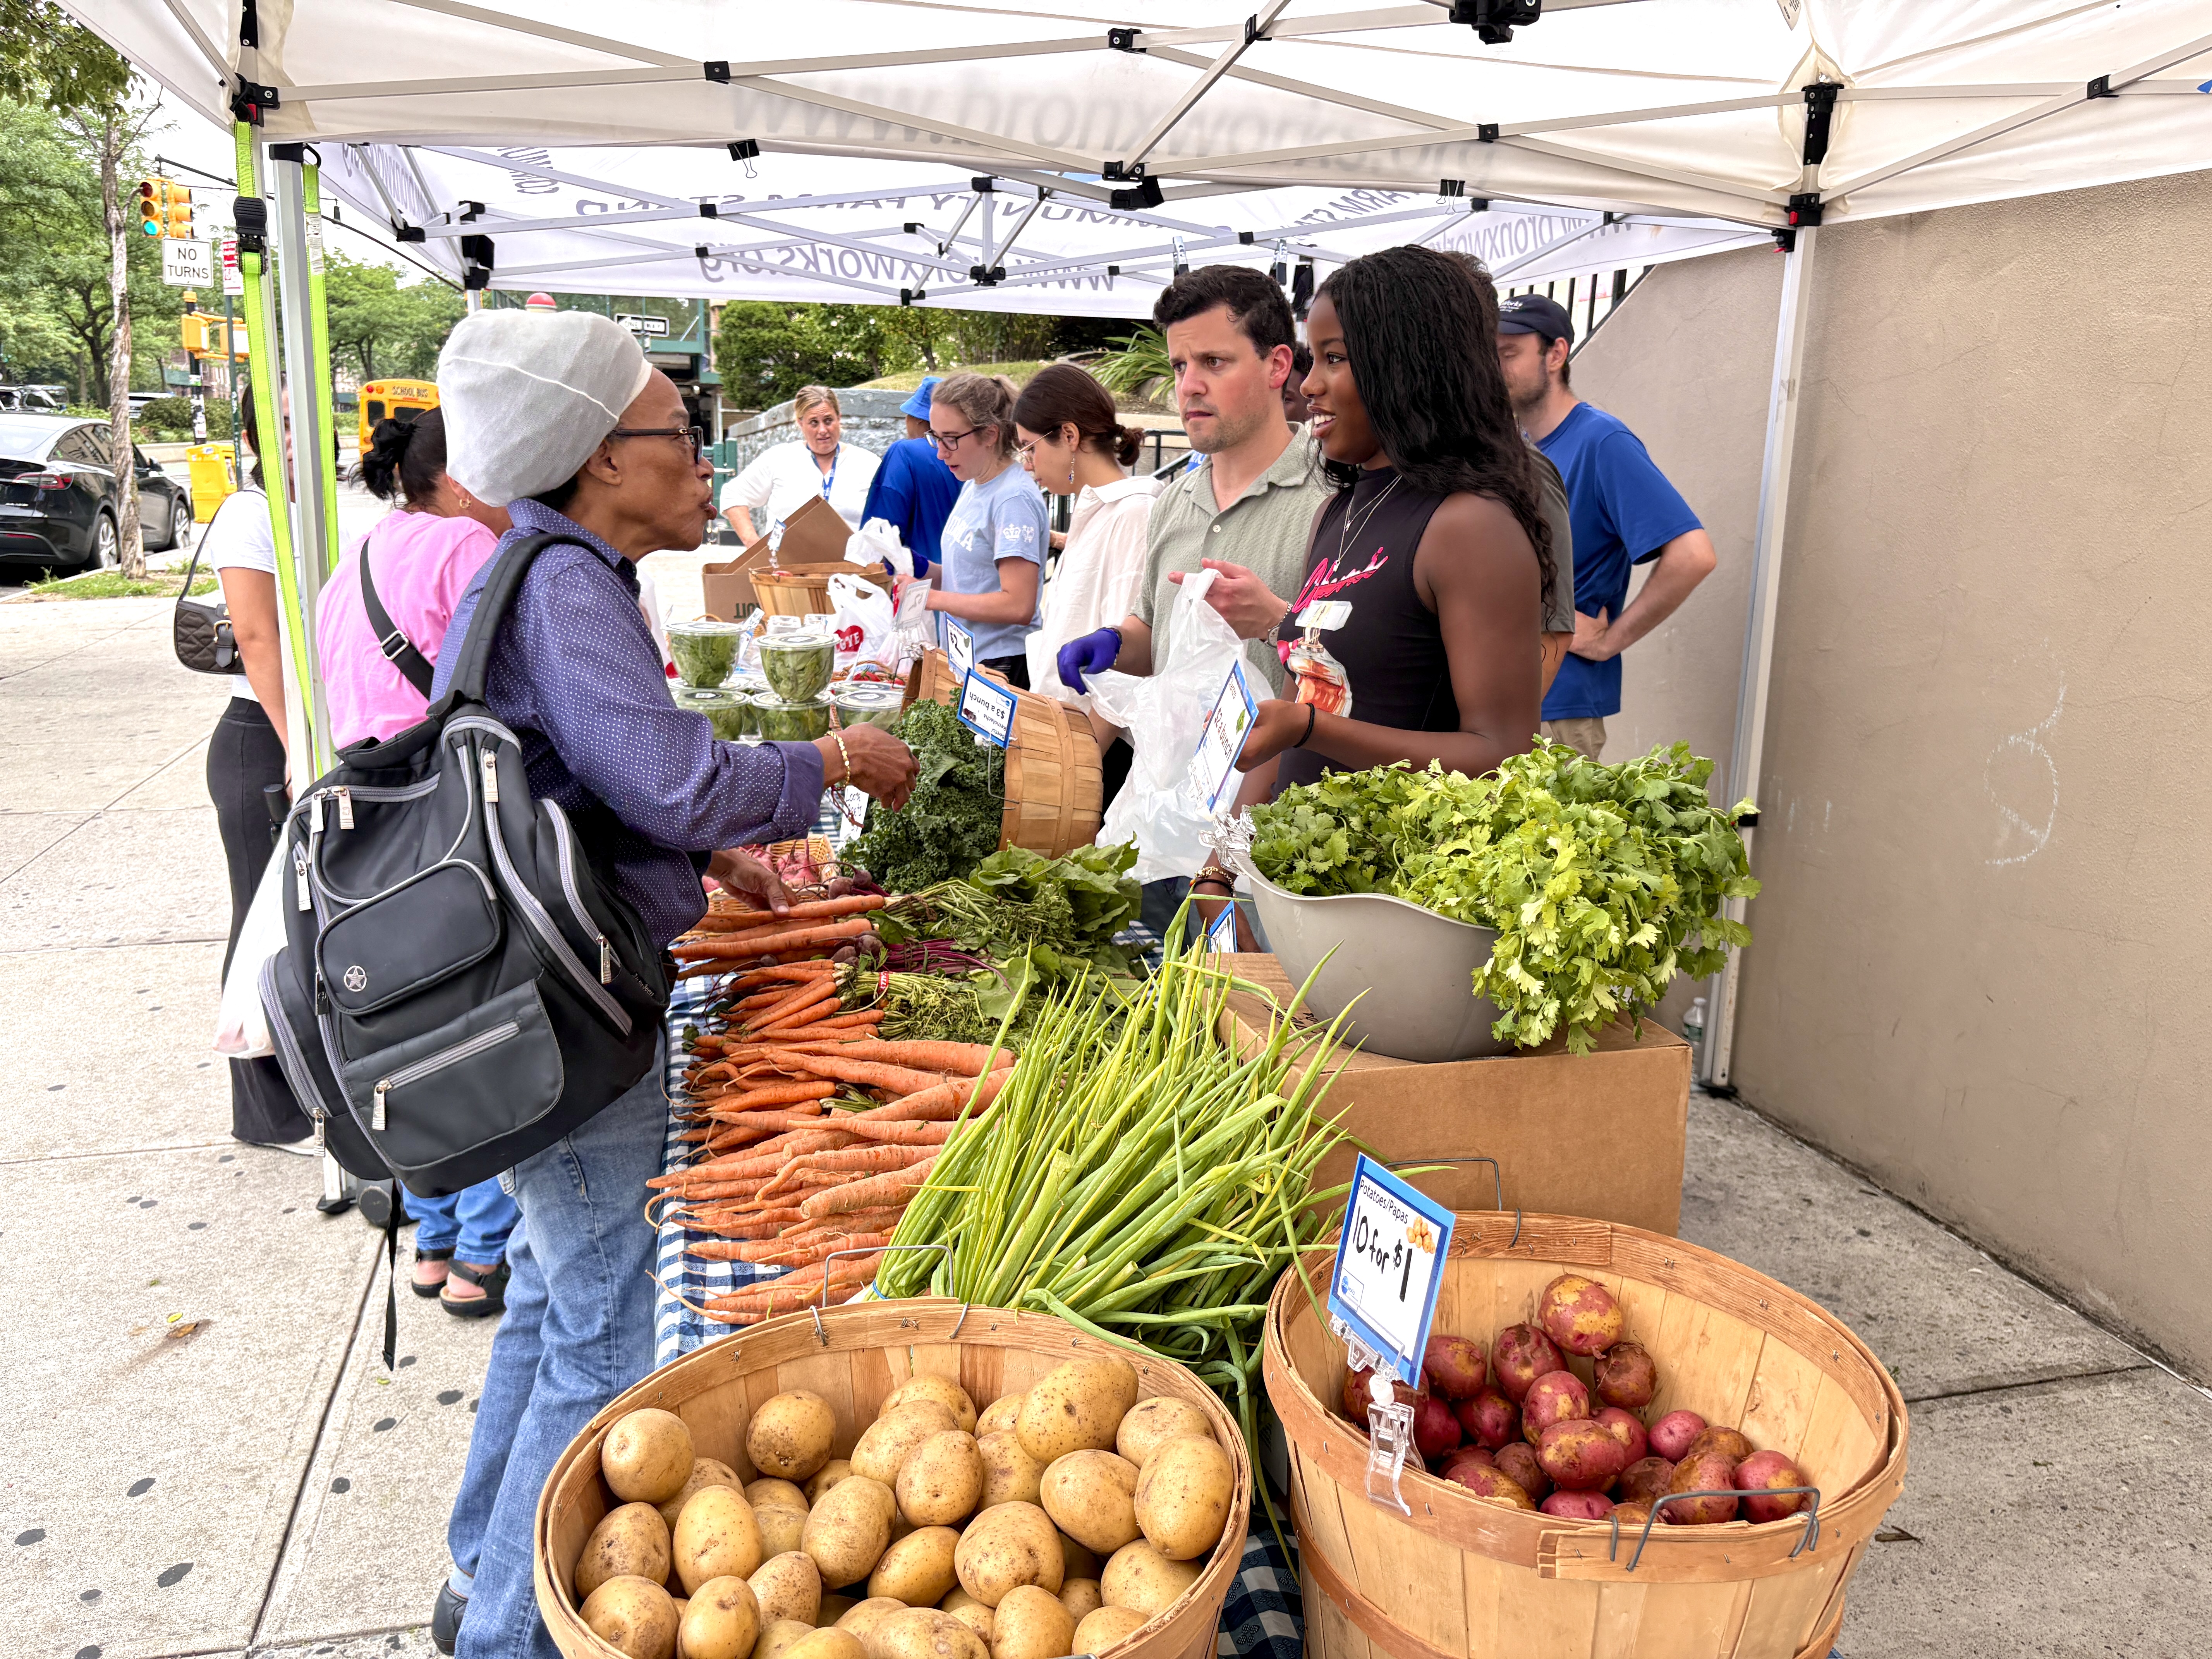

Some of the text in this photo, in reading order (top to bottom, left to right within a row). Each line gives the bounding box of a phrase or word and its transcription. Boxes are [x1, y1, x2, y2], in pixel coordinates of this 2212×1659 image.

[177, 247, 197, 260] NO
[167, 265, 209, 279] TURNS
[392, 386, 428, 397] SCHOOL BUS
[950, 629, 963, 658] $2
[969, 692, 989, 711] bunch
[996, 709, 1005, 720] $3
[1214, 706, 1223, 728] $2
[1221, 723, 1233, 761] bunch
[1359, 1179, 1408, 1224] Potatoes/Papas
[1352, 1205, 1413, 1303] 10 for $1
